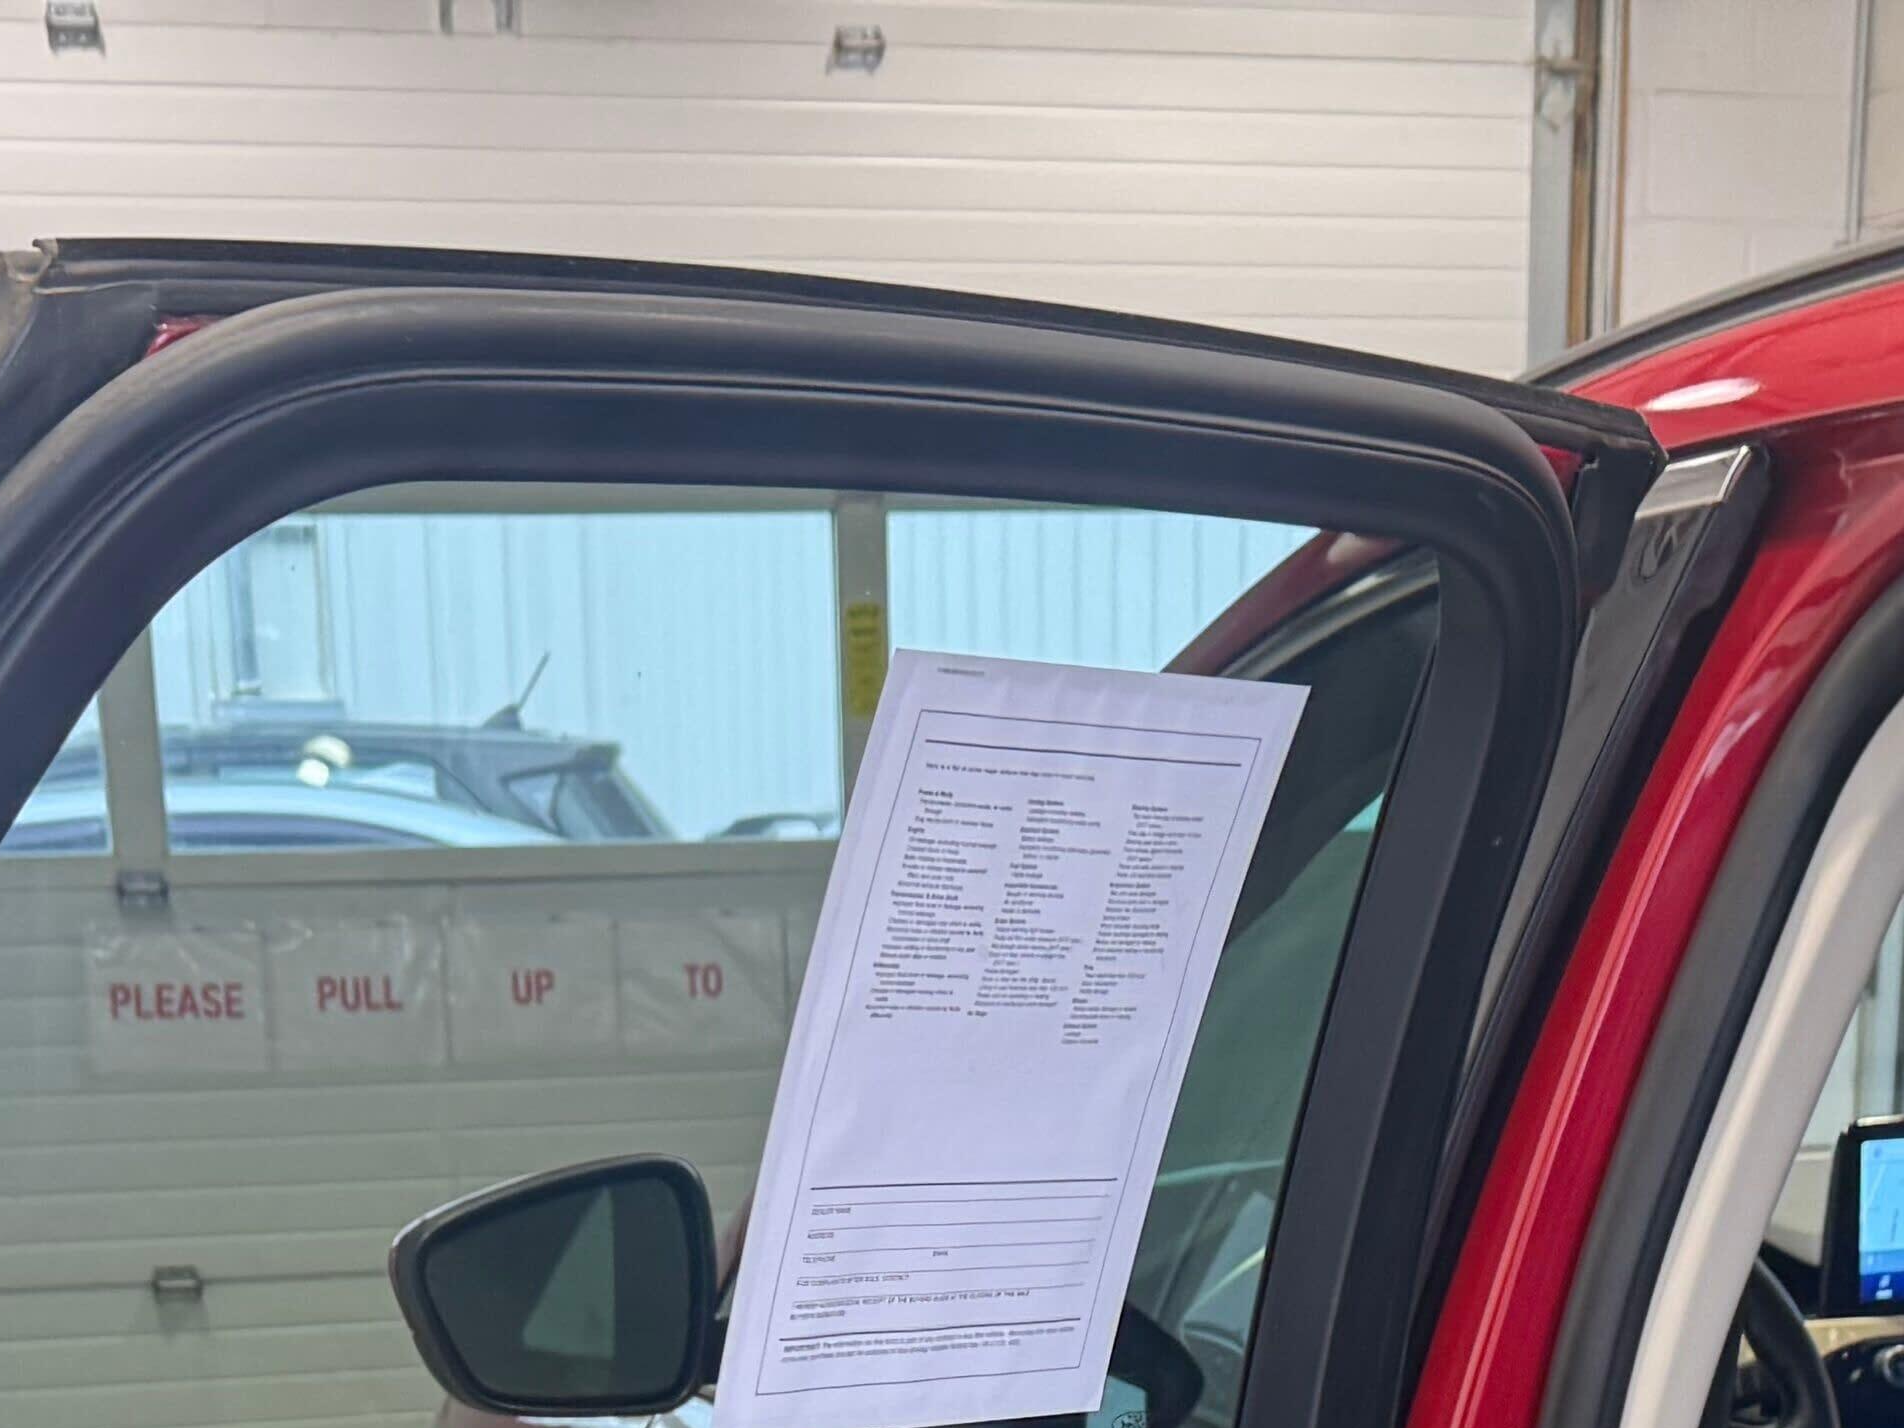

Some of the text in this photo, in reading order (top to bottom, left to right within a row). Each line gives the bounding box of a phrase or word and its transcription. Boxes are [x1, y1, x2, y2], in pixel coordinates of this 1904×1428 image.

[108, 962, 724, 1021] PLEASE PULL UP TO
